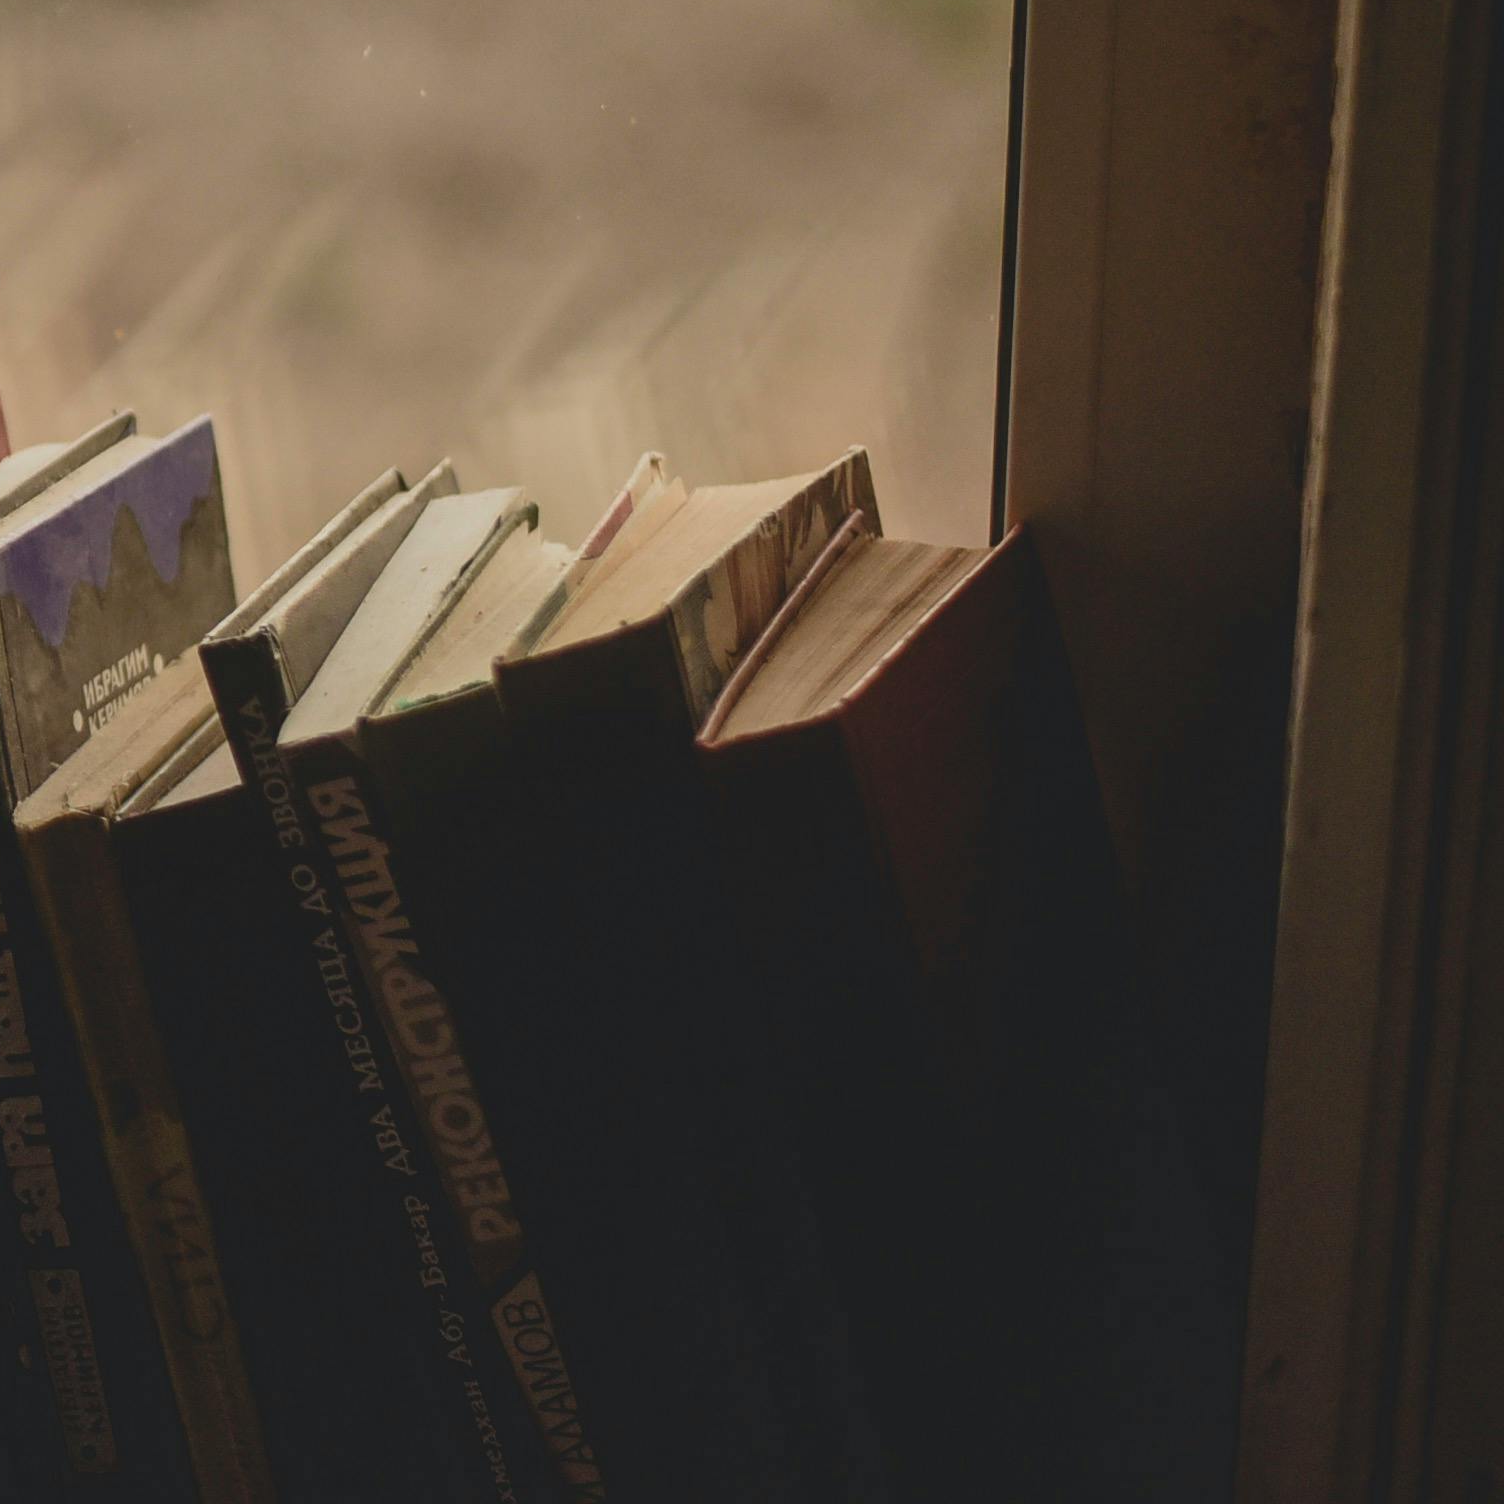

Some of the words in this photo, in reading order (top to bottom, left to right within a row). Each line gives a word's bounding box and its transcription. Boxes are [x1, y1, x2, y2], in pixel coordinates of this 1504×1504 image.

[82, 642, 149, 710] ИБРАГИМ
[239, 696, 305, 849] ЗВОНКА
[291, 864, 332, 915] ДО
[306, 776, 523, 1242] РЕКОНСТРУКЦИЯ
[312, 926, 384, 1092] МЕСЯЦА
[369, 1104, 417, 1176] ДВА
